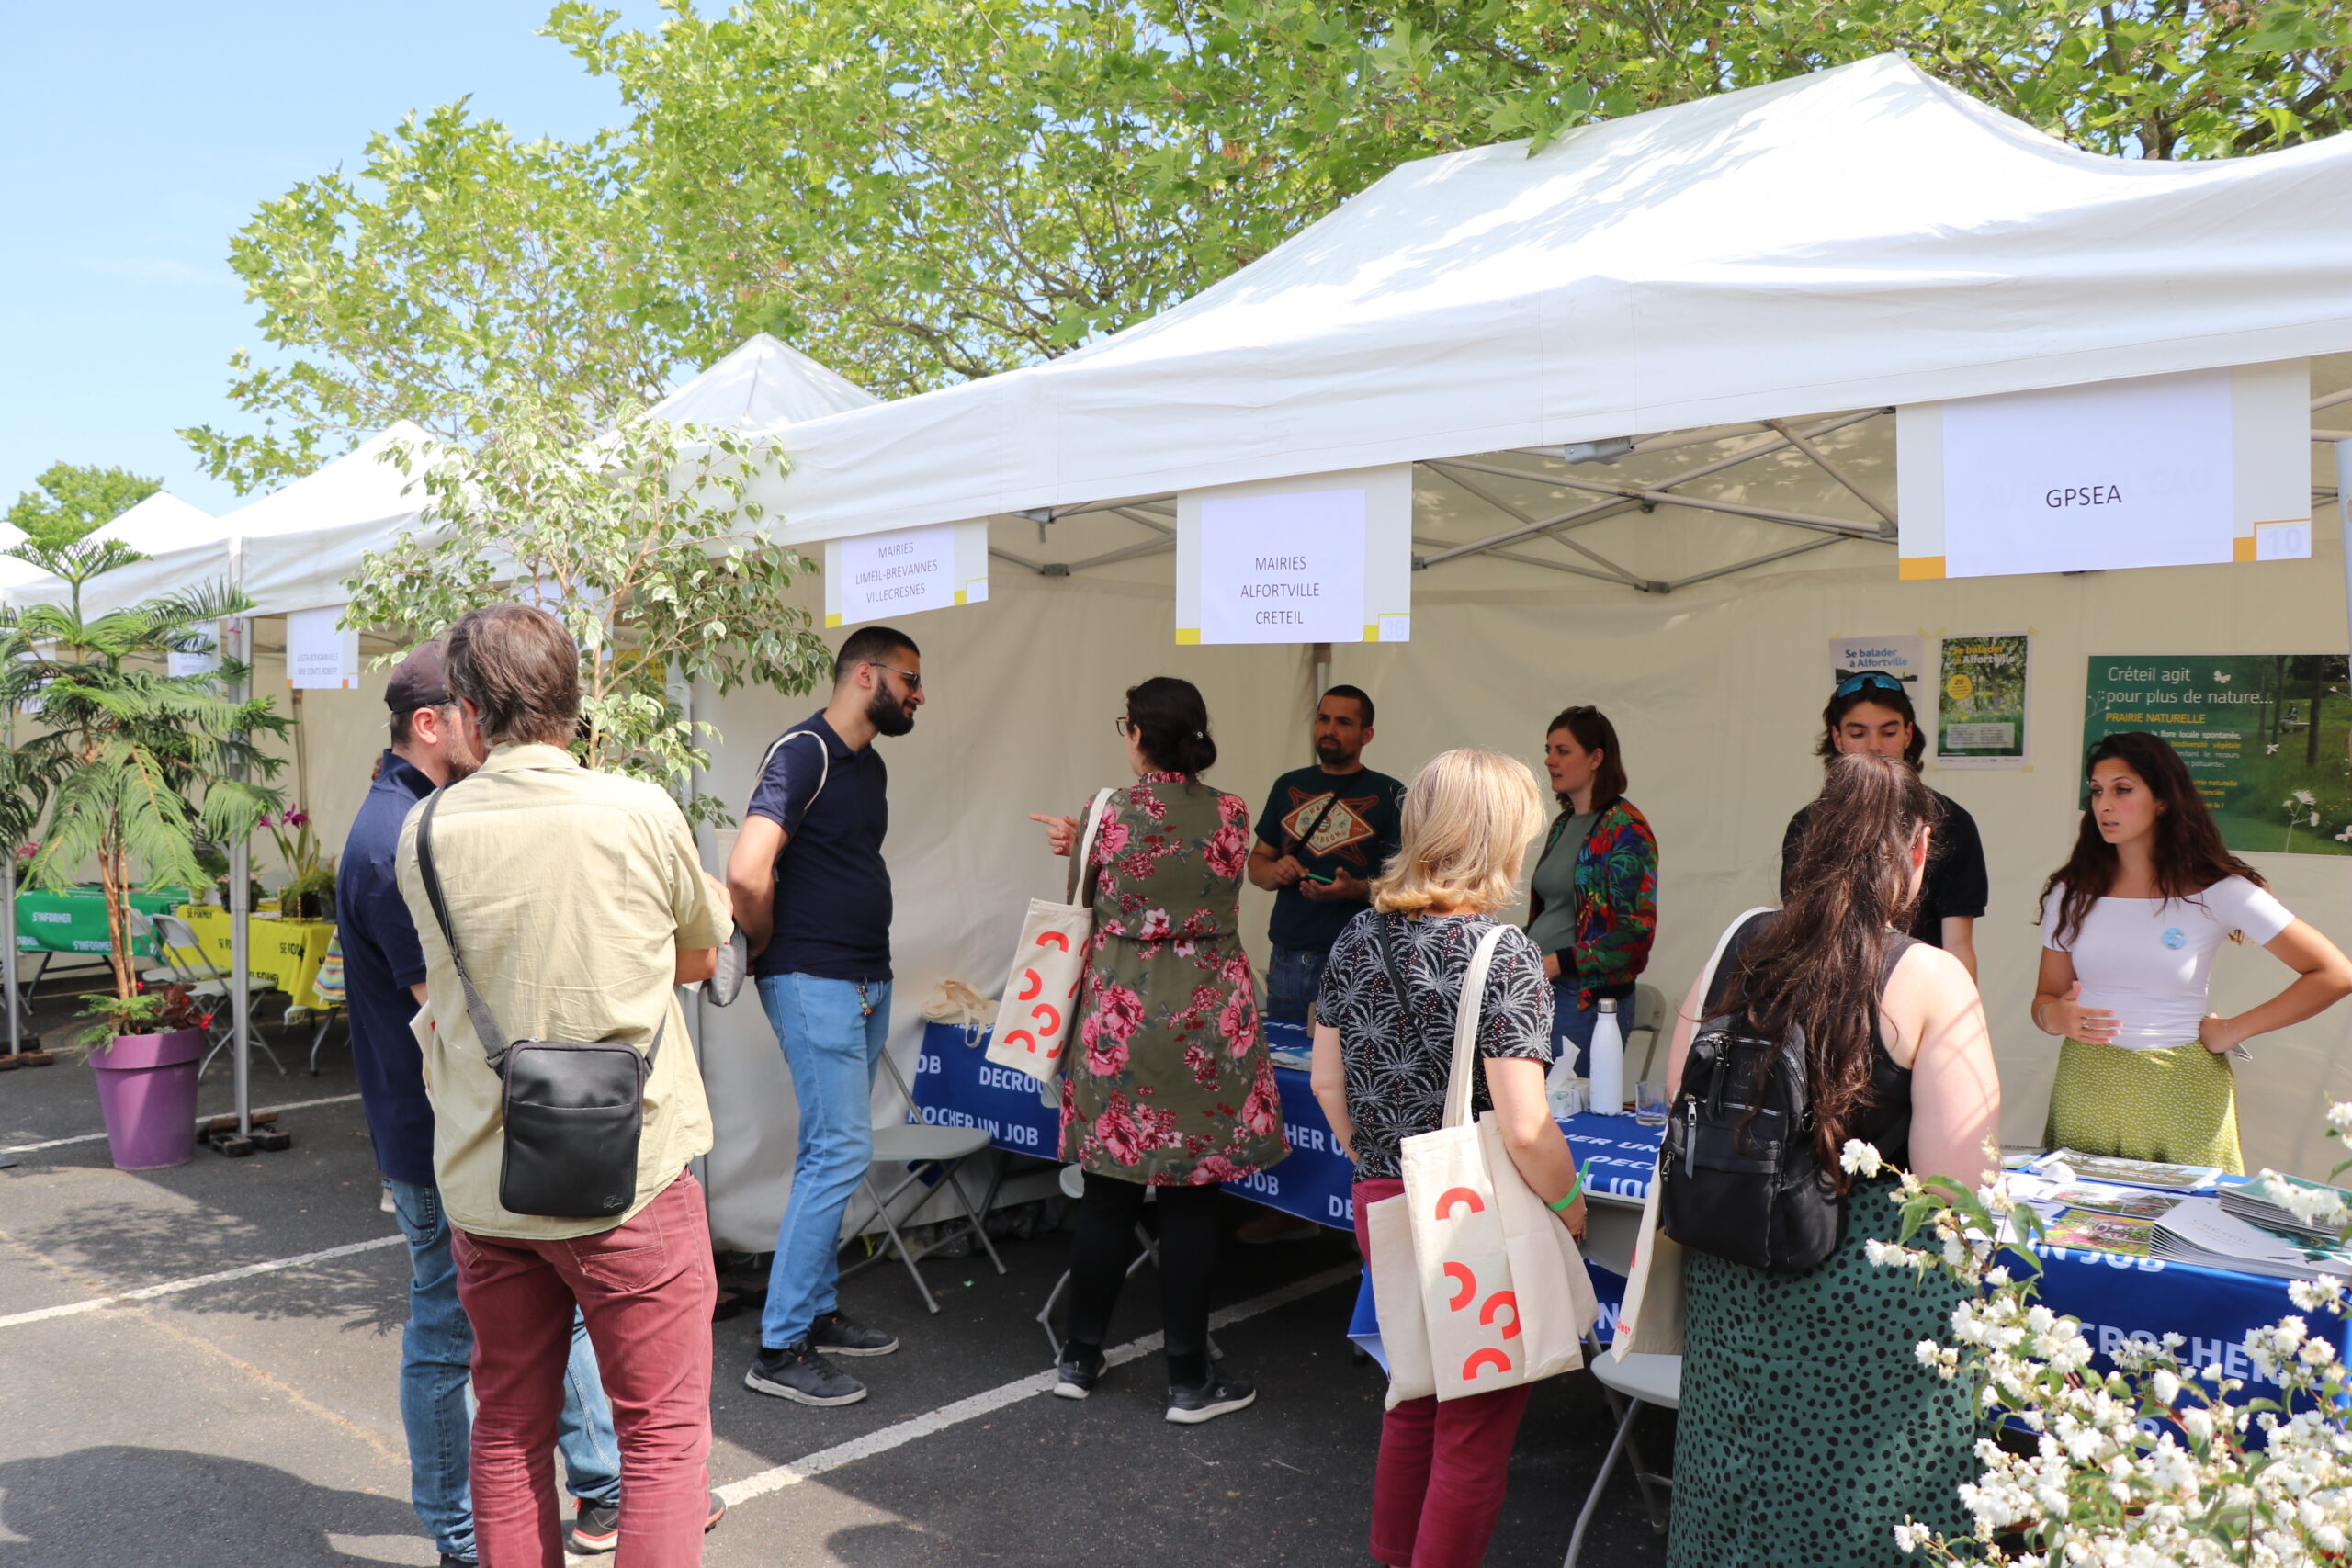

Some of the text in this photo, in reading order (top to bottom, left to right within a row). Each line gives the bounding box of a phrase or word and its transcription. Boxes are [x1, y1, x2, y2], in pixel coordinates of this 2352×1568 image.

[2045, 484, 2122, 509] GPSEA
[878, 542, 914, 558] MAIRIES
[1255, 556, 1306, 571] MAIRIES
[855, 559, 938, 585] LIMEIL-BREVANNES
[866, 582, 926, 604] VILLECRESNES
[1240, 583, 1320, 598] ALFORTVILLE
[1255, 611, 1304, 625] CRETEIL
[1846, 648, 1897, 659] Se balader
[1966, 645, 2003, 655] balader
[1849, 657, 1909, 668] à Alfortville
[1962, 653, 2016, 664] Alfortville
[2109, 666, 2191, 684] Créteil agit
[2106, 689, 2274, 705] pour plus de nature...
[2105, 712, 2206, 724] PRAIRIE NATURELLE
[2178, 730, 2199, 739] locale
[32, 911, 72, 924] S'INFORMER
[1004, 1123, 1039, 1146] JOB
[1244, 1172, 1279, 1196] JOB
